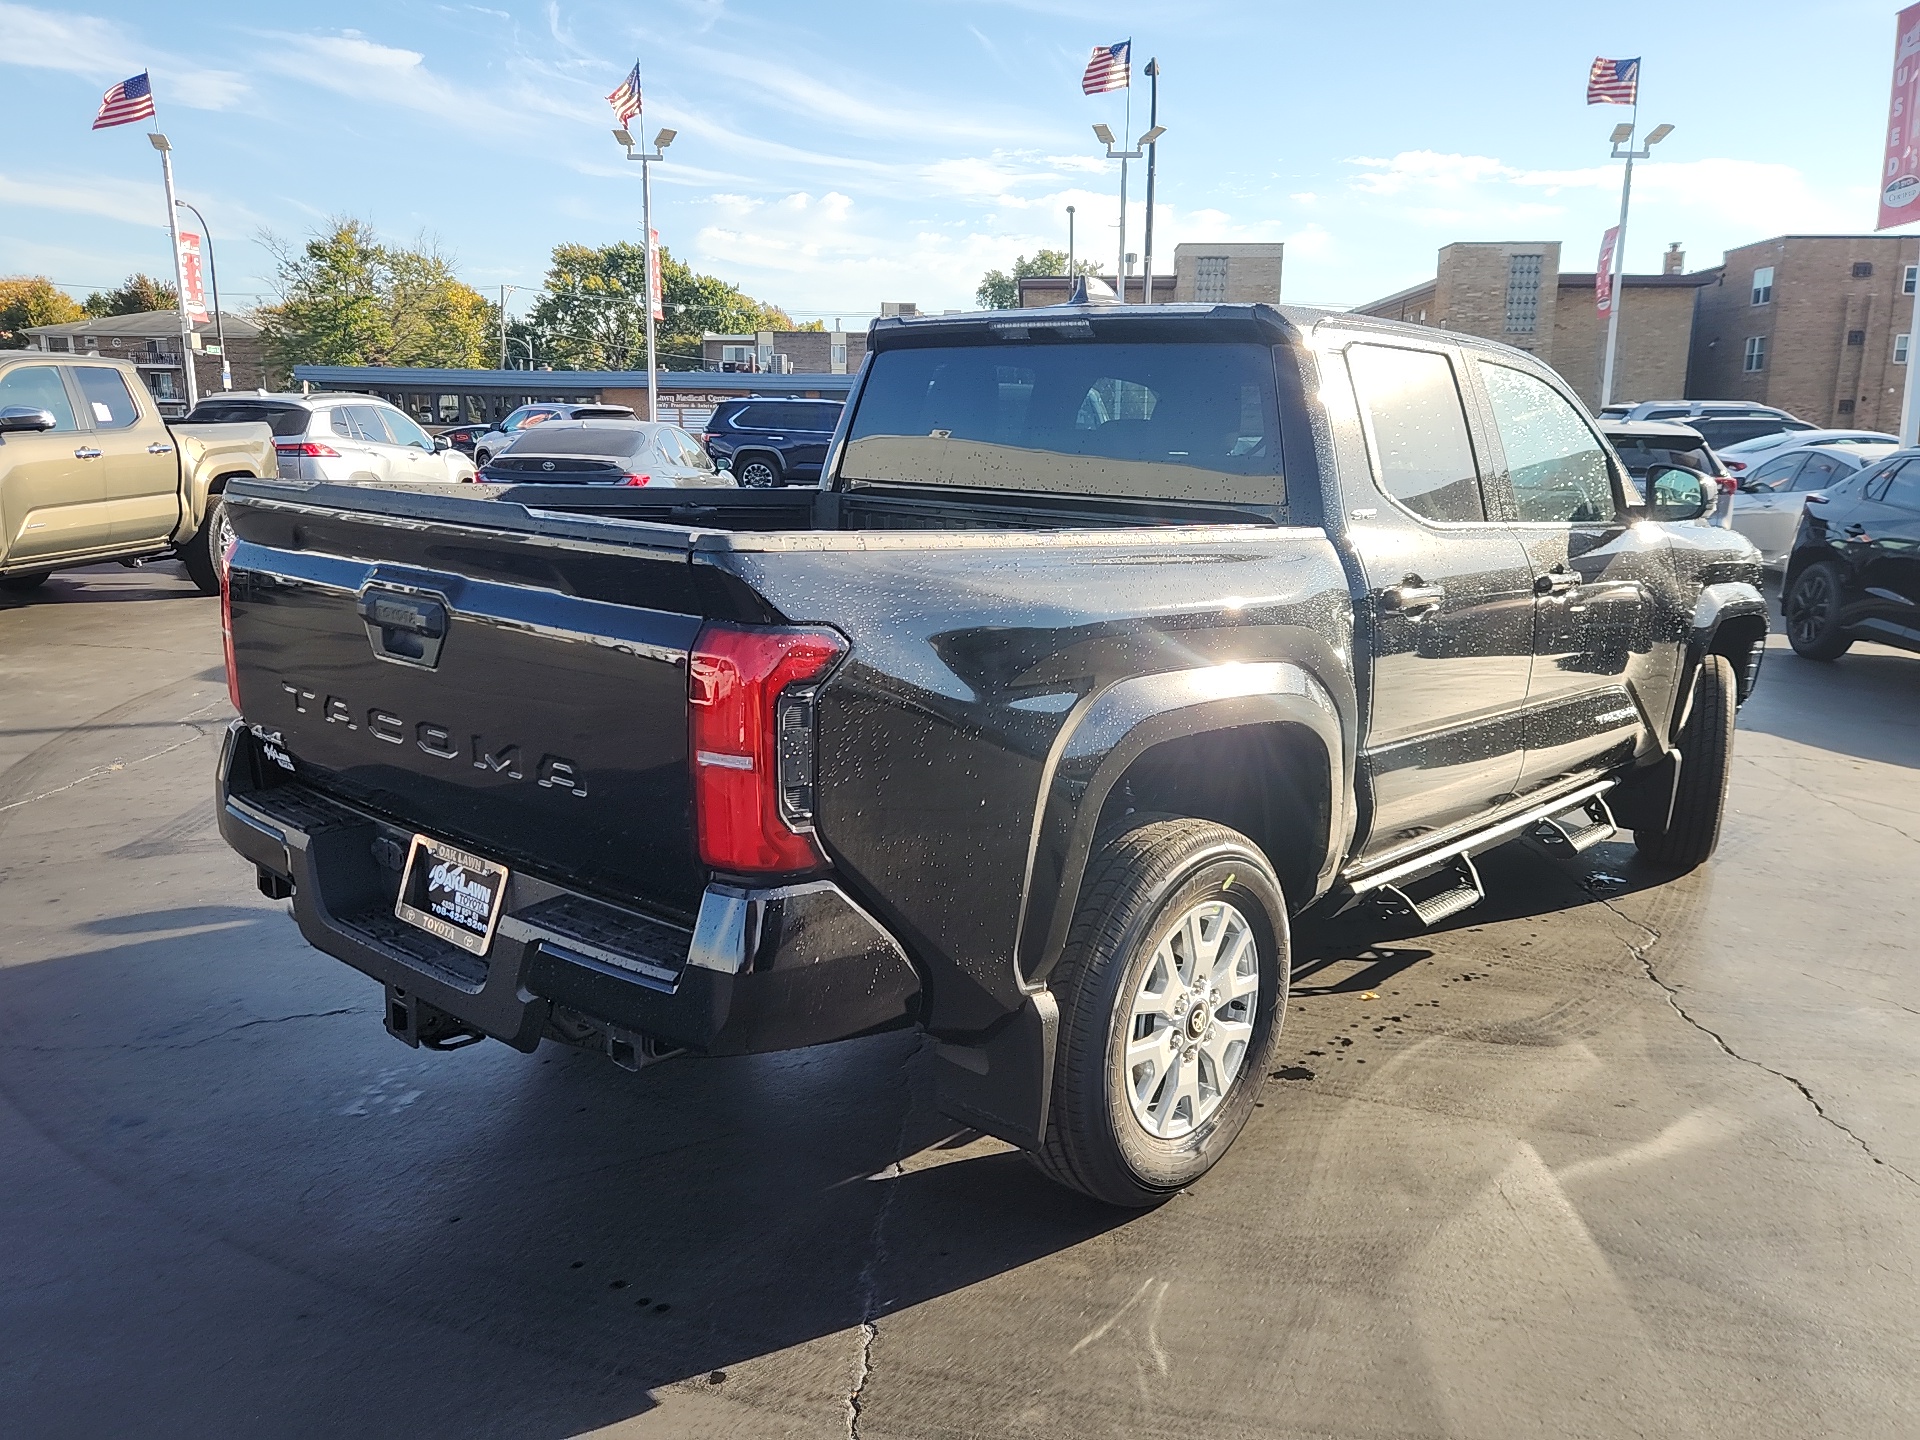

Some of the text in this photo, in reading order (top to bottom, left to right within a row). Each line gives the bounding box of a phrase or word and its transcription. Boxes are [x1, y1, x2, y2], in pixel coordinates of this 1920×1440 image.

[1888, 65, 1909, 176] USED
[193, 257, 203, 302] CARS
[676, 394, 706, 402] Medical
[376, 605, 417, 625] TOYOTA
[282, 680, 589, 798] TACOMA
[439, 845, 482, 871] OAK LAWN
[455, 904, 462, 914] W
[459, 893, 485, 914] TOYOTA
[422, 916, 455, 940] TOYOTA
[431, 902, 488, 933] 708-423-5200
[1274, 940, 1289, 1024] TOYO
